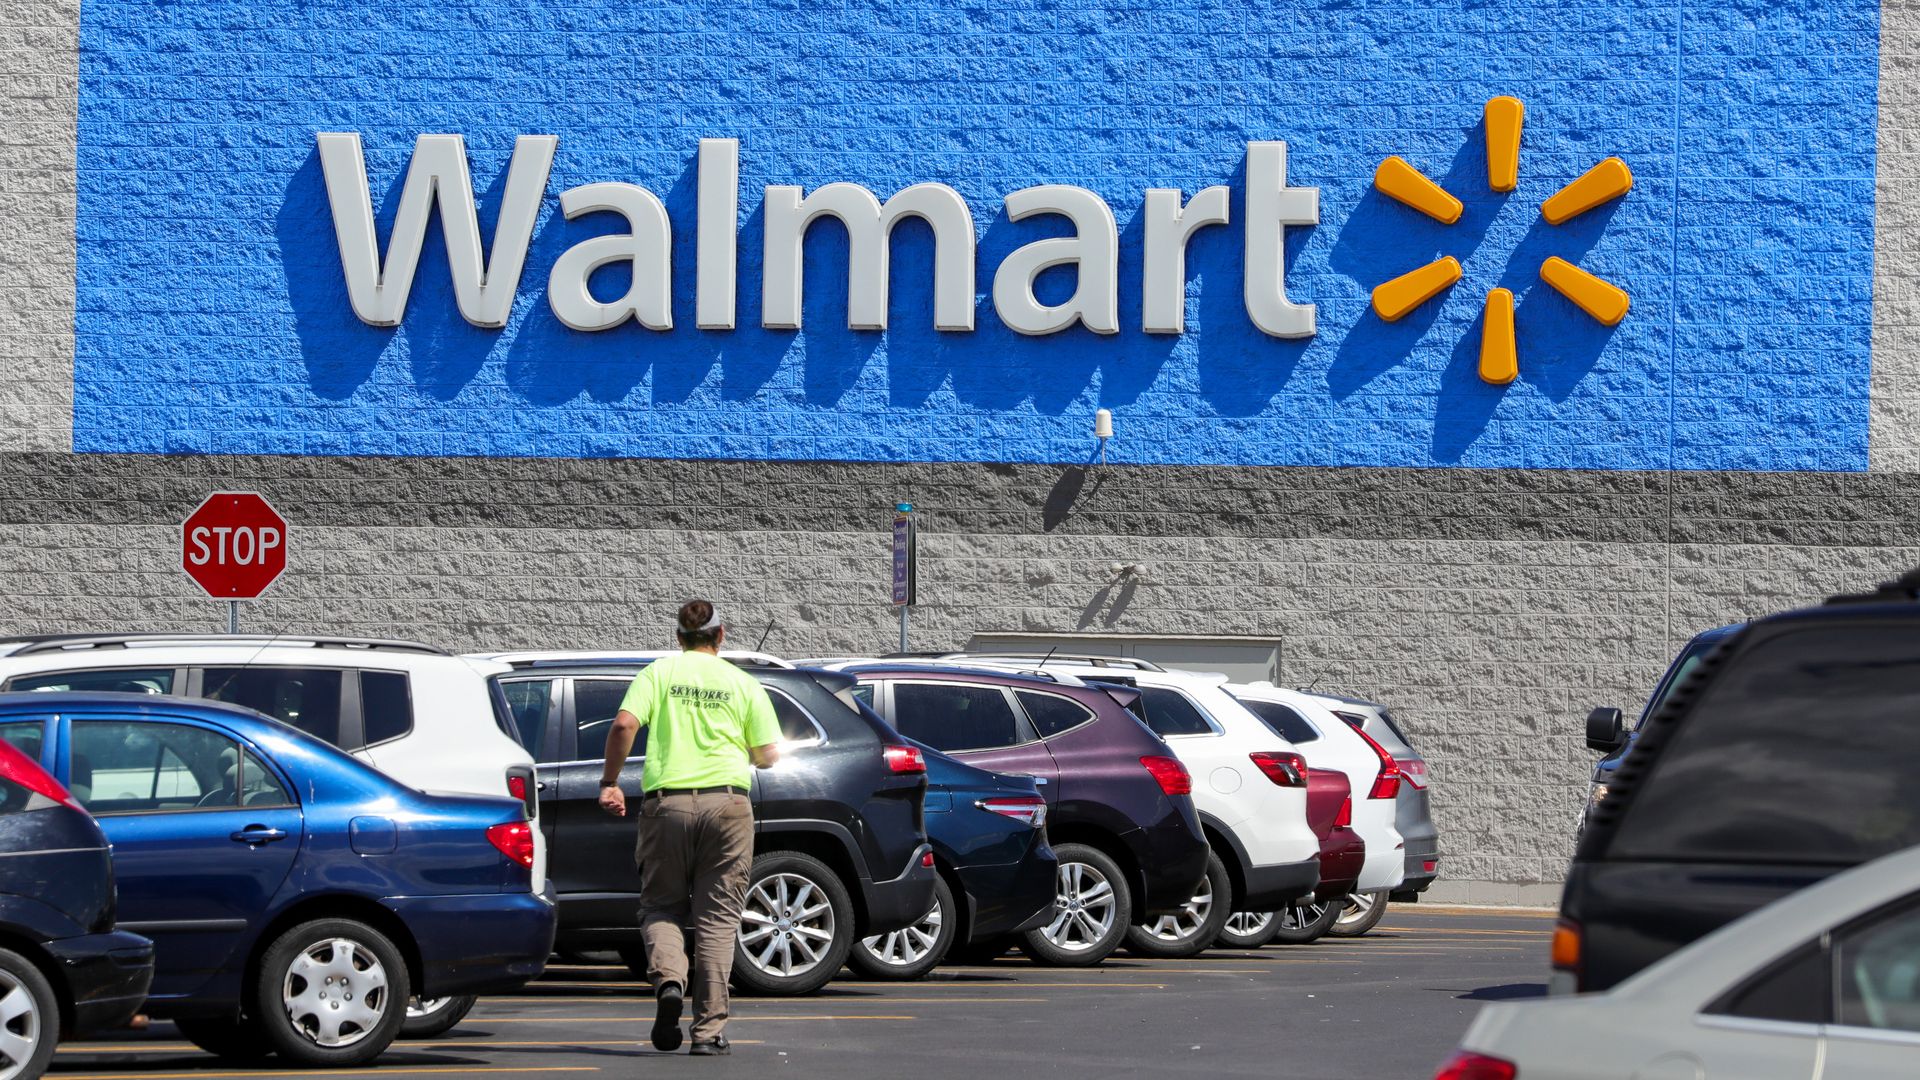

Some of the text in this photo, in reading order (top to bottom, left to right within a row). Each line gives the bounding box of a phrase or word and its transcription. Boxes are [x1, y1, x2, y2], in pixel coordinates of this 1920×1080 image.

[317, 131, 1320, 339] Walmart
[189, 526, 280, 565] STOP
[670, 685, 730, 701] SKYWORKS
